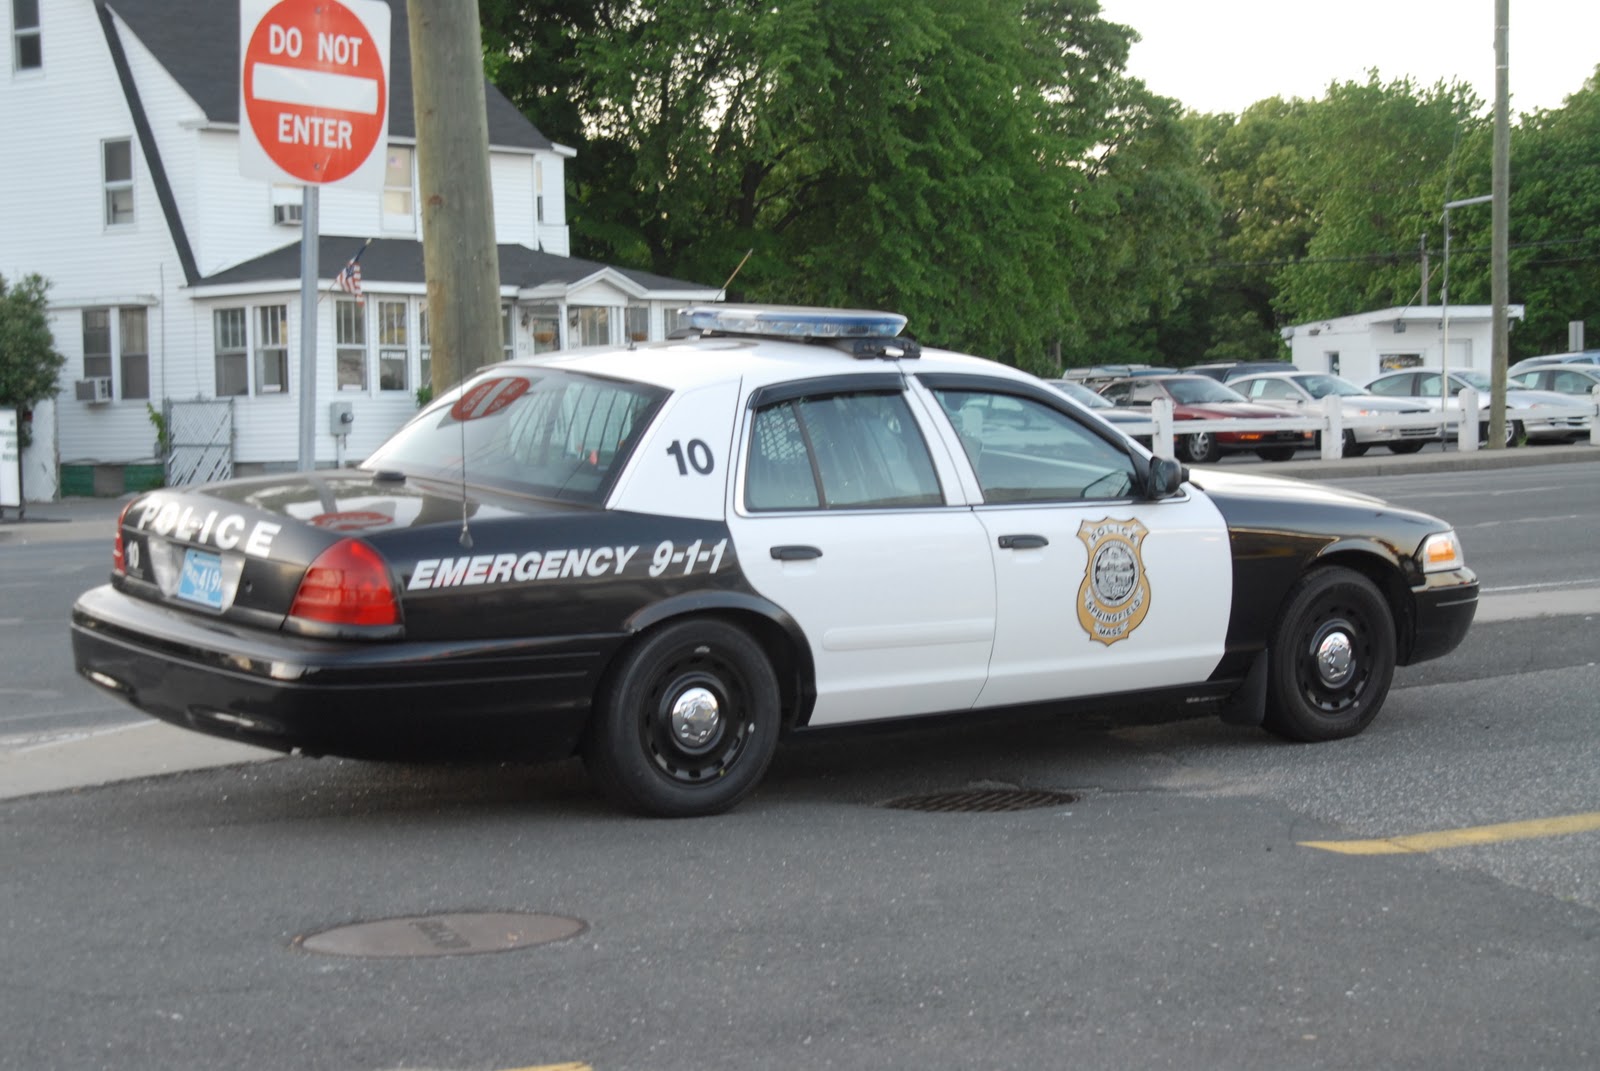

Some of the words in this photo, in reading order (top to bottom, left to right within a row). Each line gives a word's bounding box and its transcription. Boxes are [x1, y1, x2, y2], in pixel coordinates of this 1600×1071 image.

[269, 24, 303, 58] DO
[317, 32, 363, 67] NOT
[278, 113, 353, 150] ENTER
[667, 438, 715, 476] 10
[136, 501, 282, 558] POLICE
[1091, 524, 1137, 541] POLICE
[407, 545, 639, 590] EMERGENCY
[649, 538, 728, 577] 9-1-1
[1086, 600, 1141, 622] SPRINGFIELD
[1099, 626, 1123, 637] MASS
